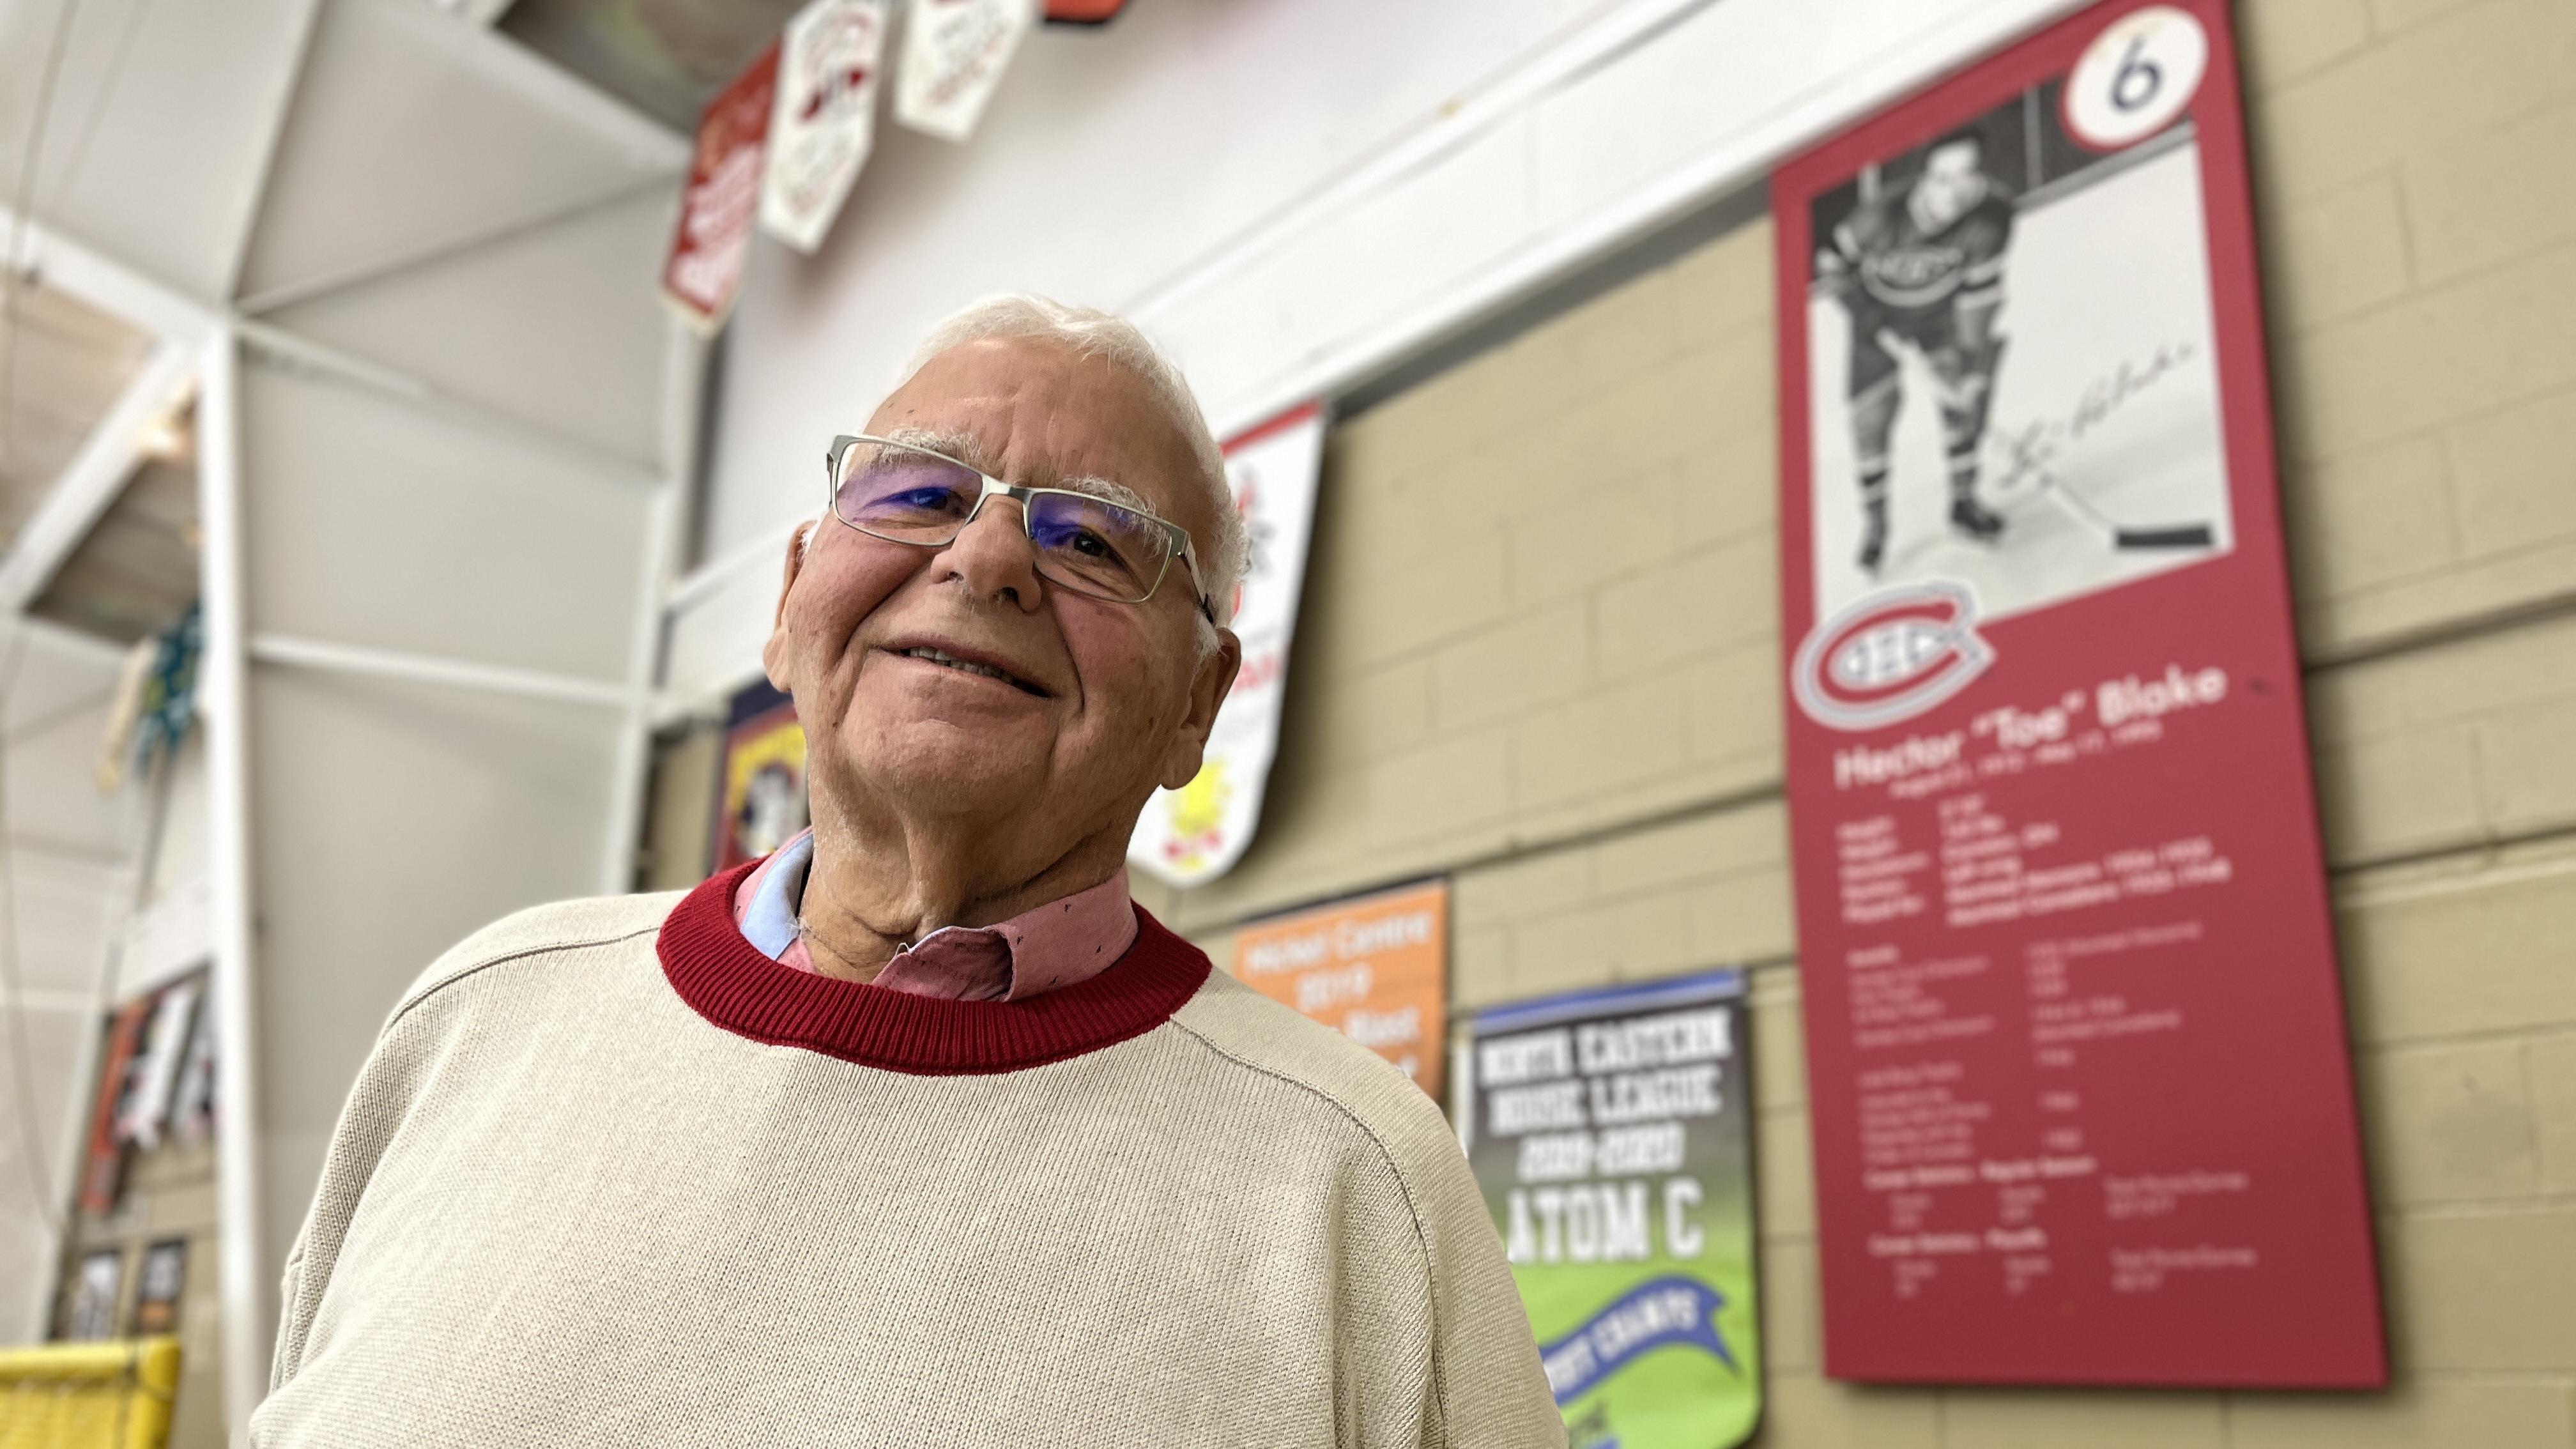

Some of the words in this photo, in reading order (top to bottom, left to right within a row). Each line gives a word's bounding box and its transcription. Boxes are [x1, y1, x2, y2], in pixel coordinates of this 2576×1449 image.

[2108, 37, 2165, 114] 6
[1834, 728, 1965, 790] Hector
[2096, 663, 2227, 726] Blake
[1479, 1029, 1574, 1088] NORTH
[1577, 1008, 1731, 1075] EASTERN
[1489, 1081, 1587, 1136] HOUSE
[1591, 1064, 1722, 1123] LEAGUE
[1507, 1179, 1650, 1264] ATOM
[1664, 1177, 1704, 1259] C
